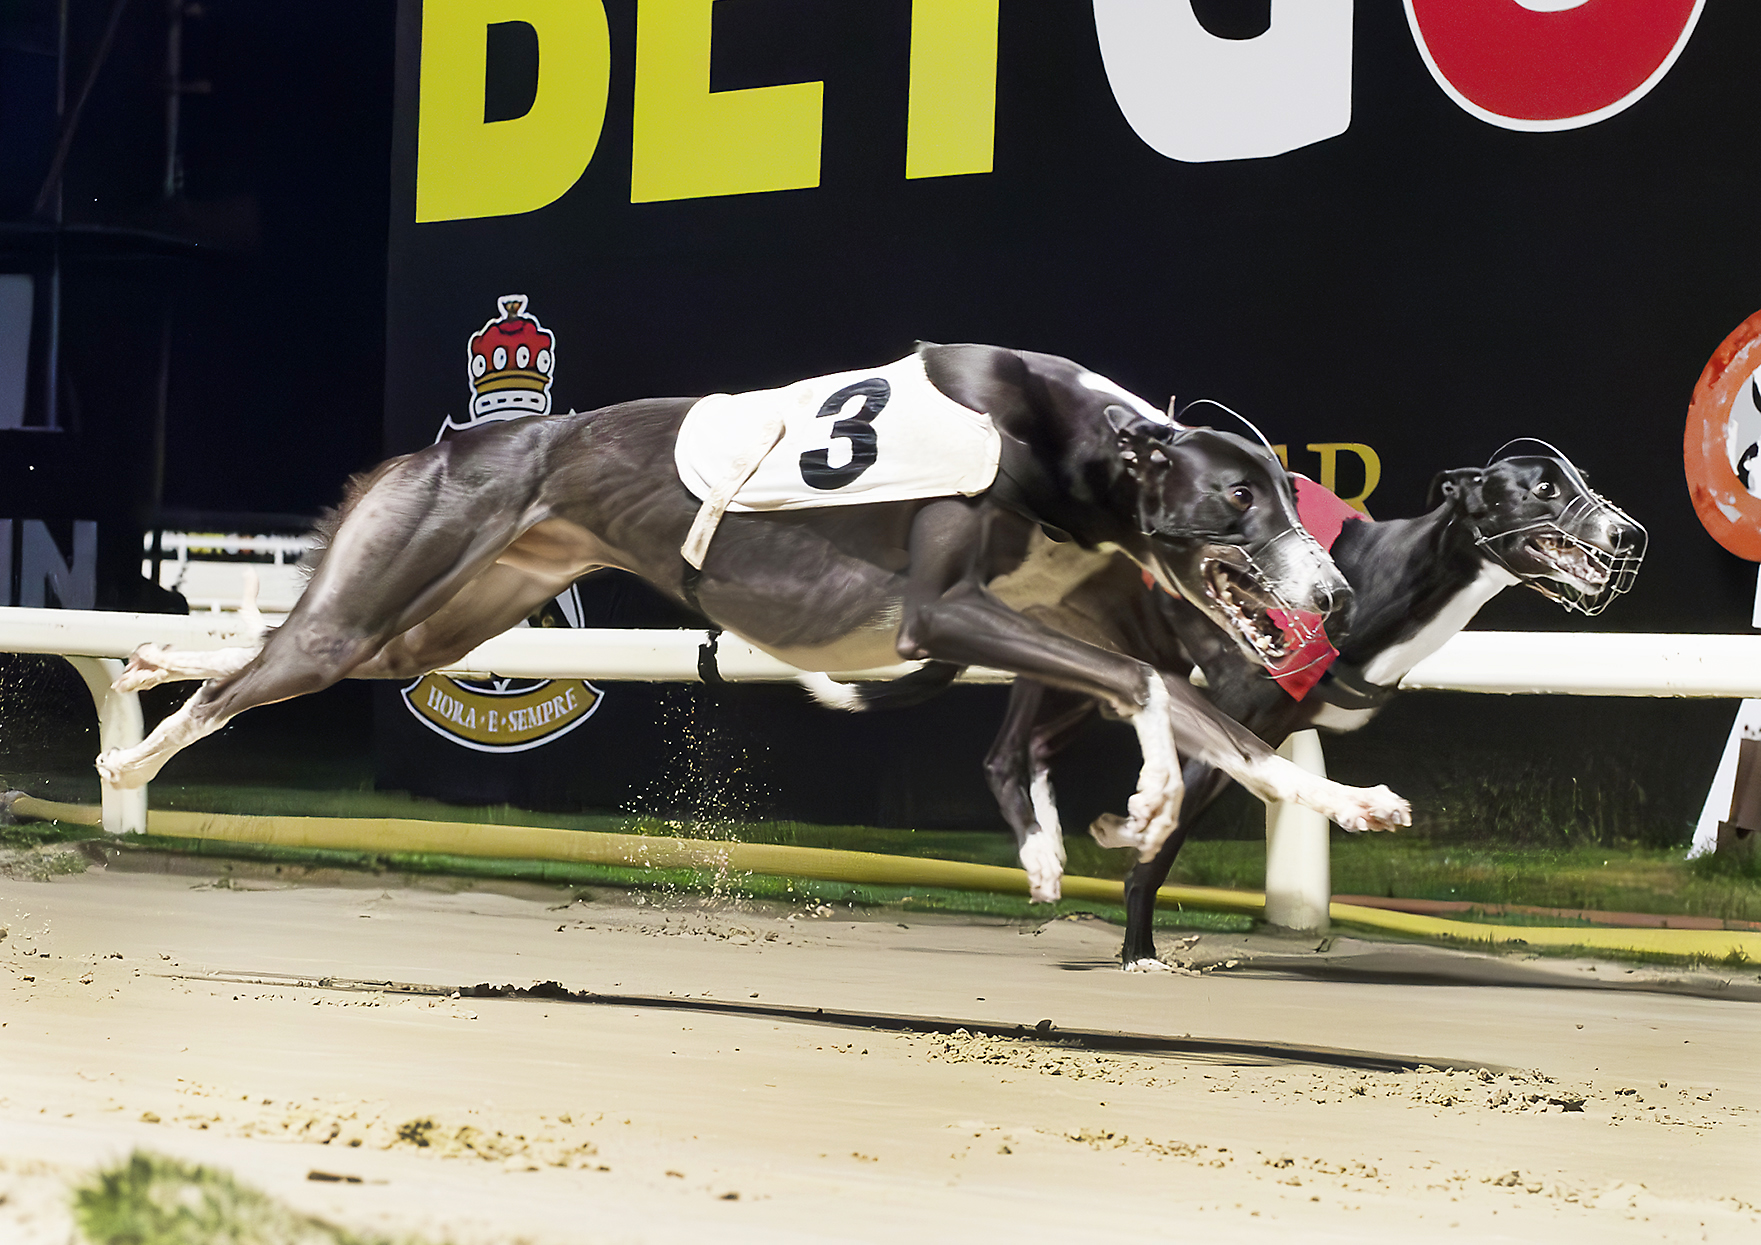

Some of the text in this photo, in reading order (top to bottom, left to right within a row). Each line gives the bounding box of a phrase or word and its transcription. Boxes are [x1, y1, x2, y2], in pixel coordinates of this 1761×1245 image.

[799, 377, 892, 491] 3
[427, 684, 579, 733] HORA E SEMPRE
